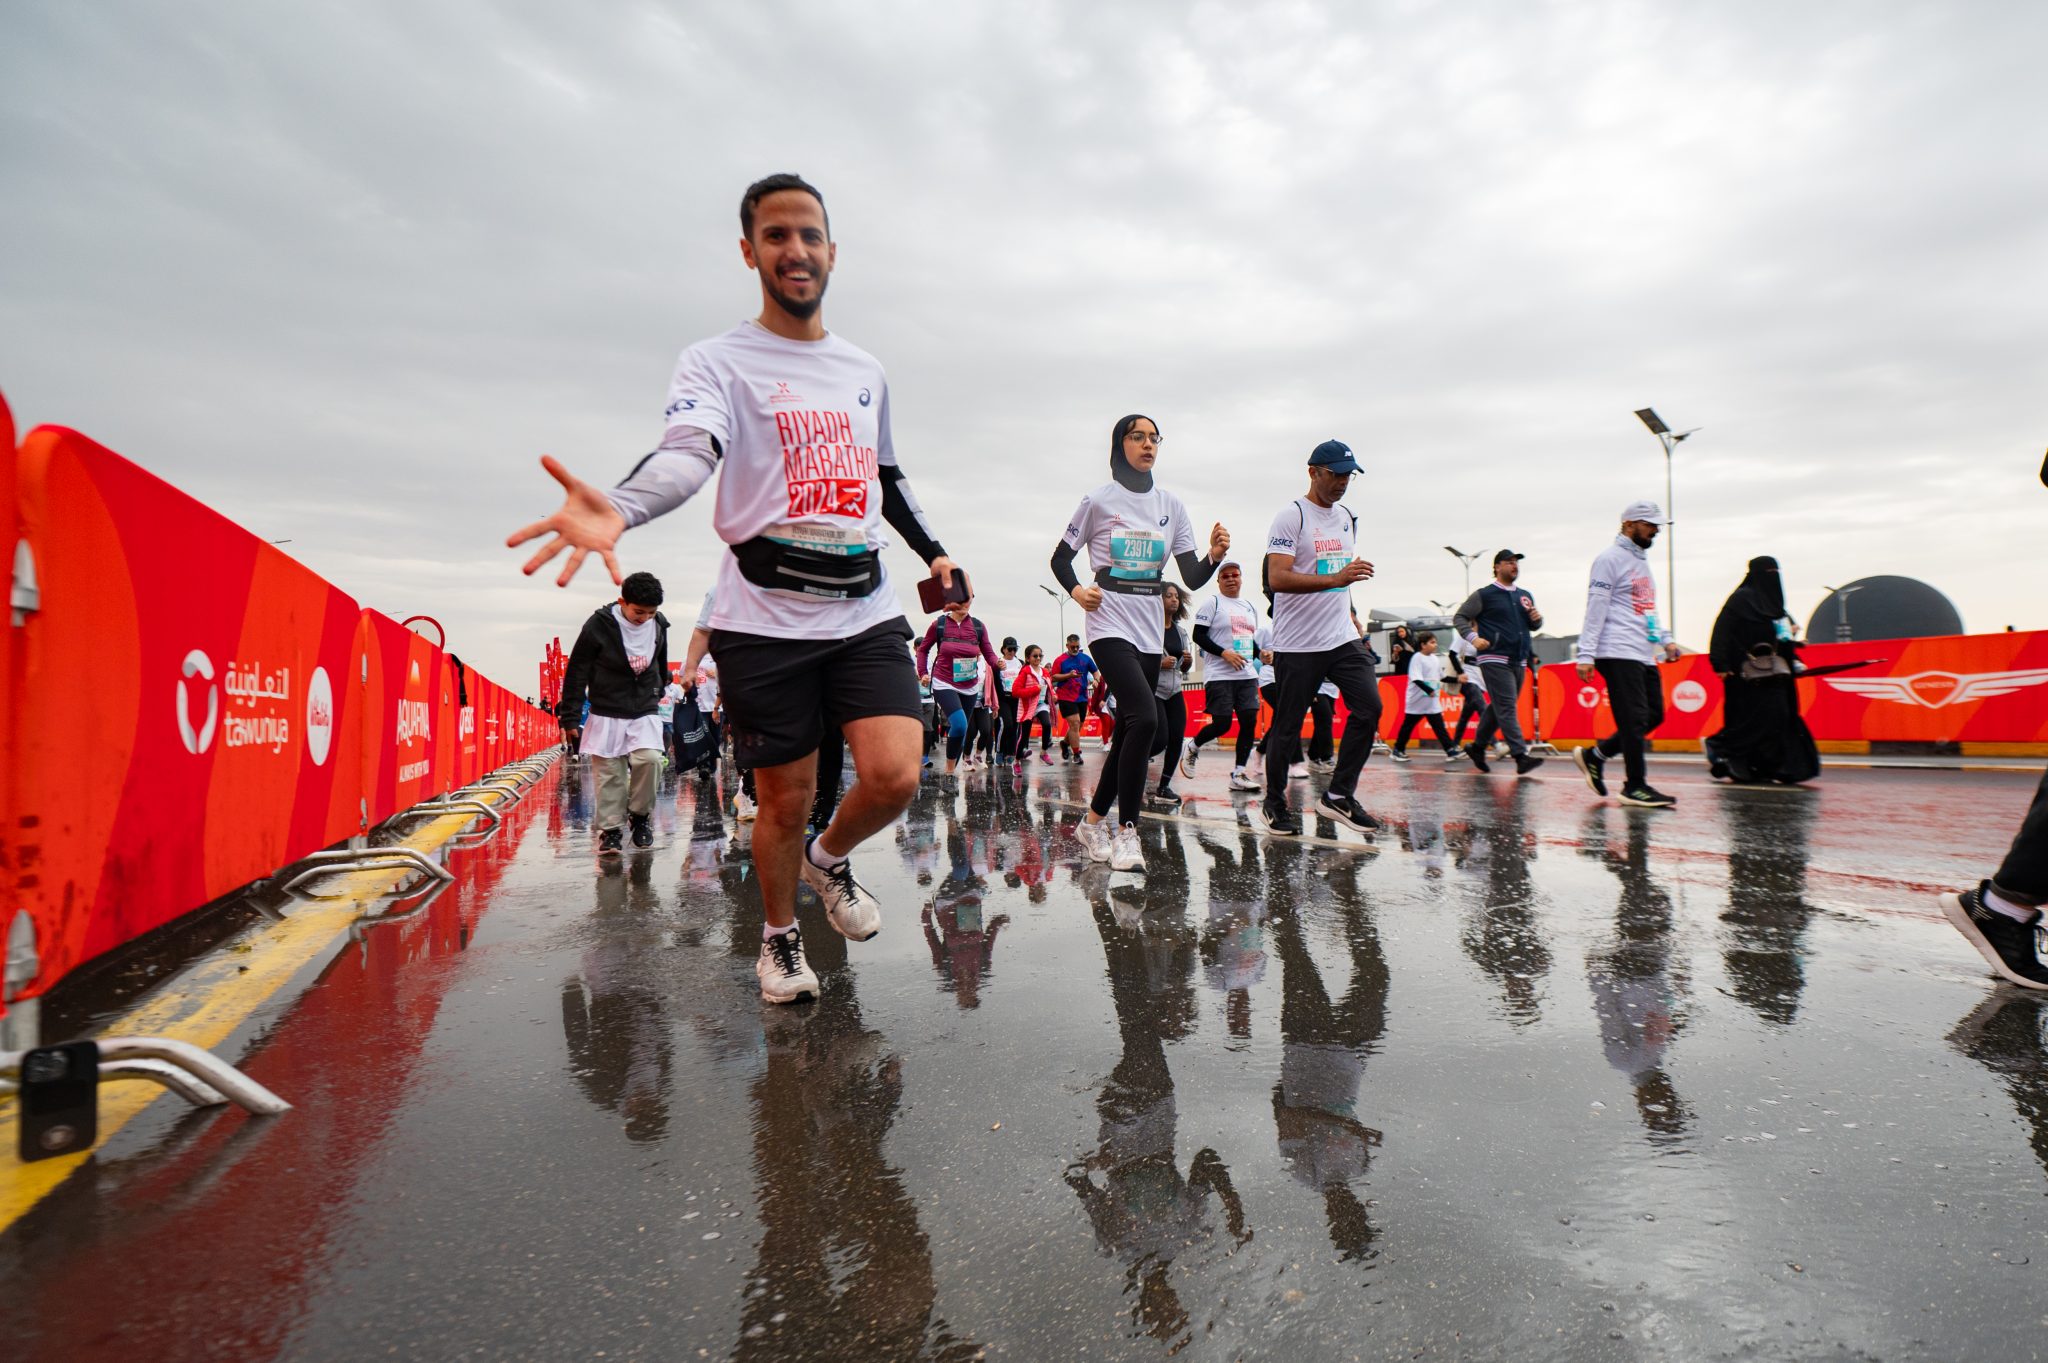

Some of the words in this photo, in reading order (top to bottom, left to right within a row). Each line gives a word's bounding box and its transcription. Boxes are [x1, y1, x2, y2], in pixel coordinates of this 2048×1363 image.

[776, 411, 853, 446] RIYADH
[788, 481, 840, 515] 2024
[1124, 538, 1153, 559] 23914
[1314, 538, 1343, 553] RIYADH
[224, 707, 289, 754] tawuniya
[396, 698, 431, 748] AQUAFINA
